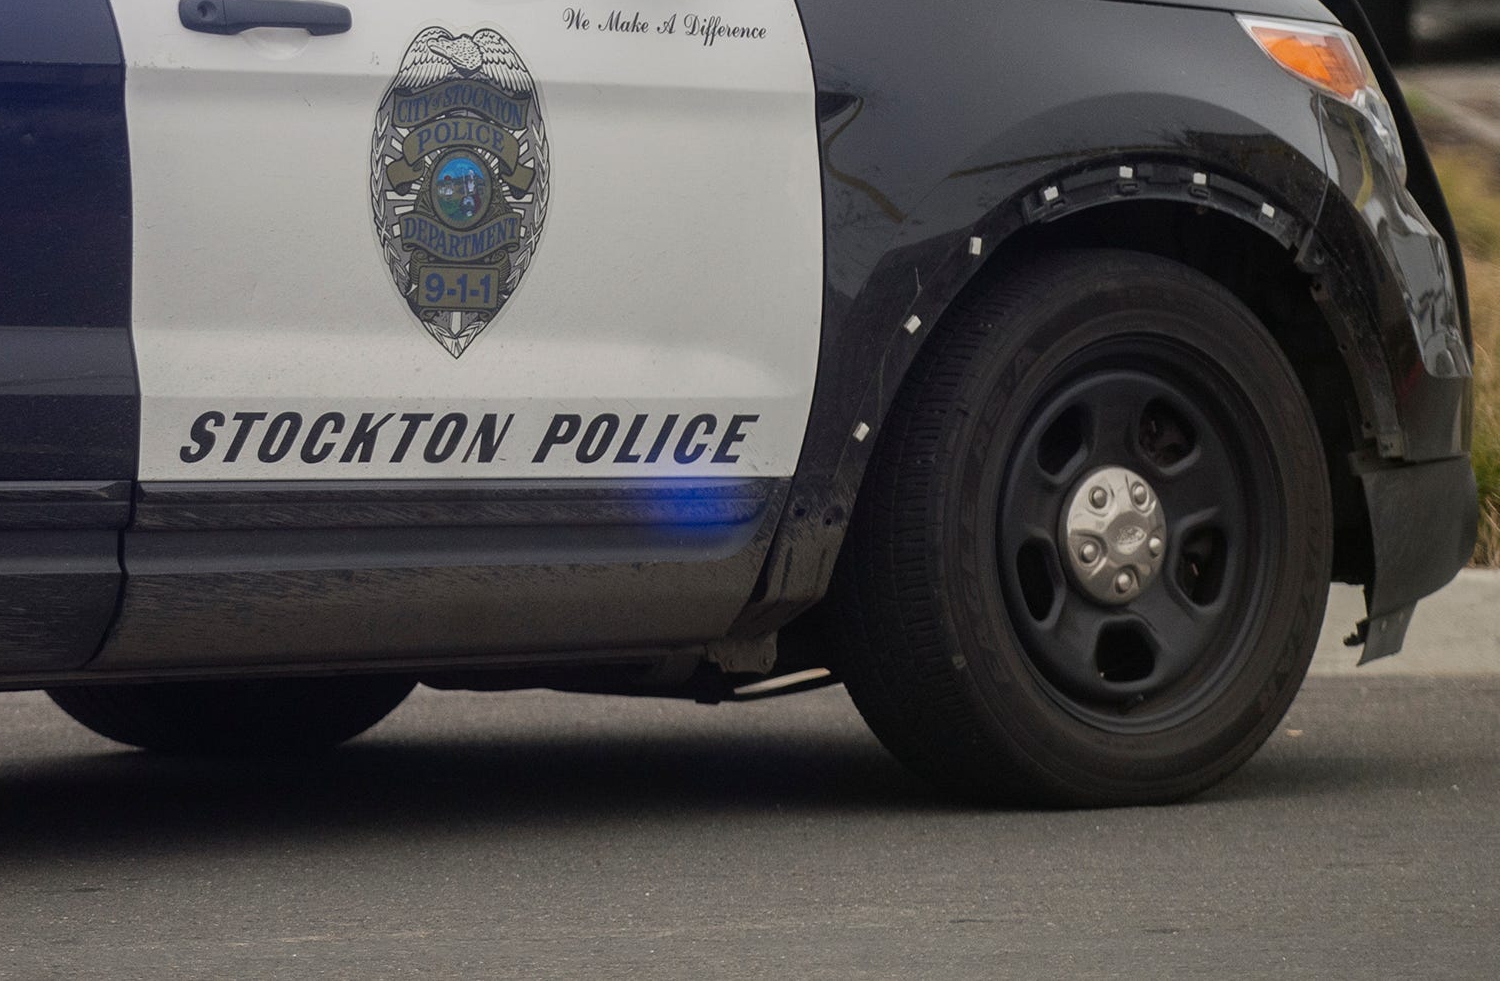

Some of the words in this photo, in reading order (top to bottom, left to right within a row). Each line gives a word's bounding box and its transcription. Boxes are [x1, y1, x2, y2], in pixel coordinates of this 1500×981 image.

[562, 7, 590, 30] We
[597, 9, 650, 33] Make
[656, 12, 677, 34] A
[683, 13, 767, 46] Difference
[396, 96, 431, 123] CITY
[443, 83, 525, 127] STOCKTON
[416, 121, 505, 153] POLICE
[404, 217, 518, 259] DEPARTMENT
[424, 271, 492, 304] 9-1-1
[179, 411, 514, 464] STOCKTON
[532, 414, 759, 464] POLICE
